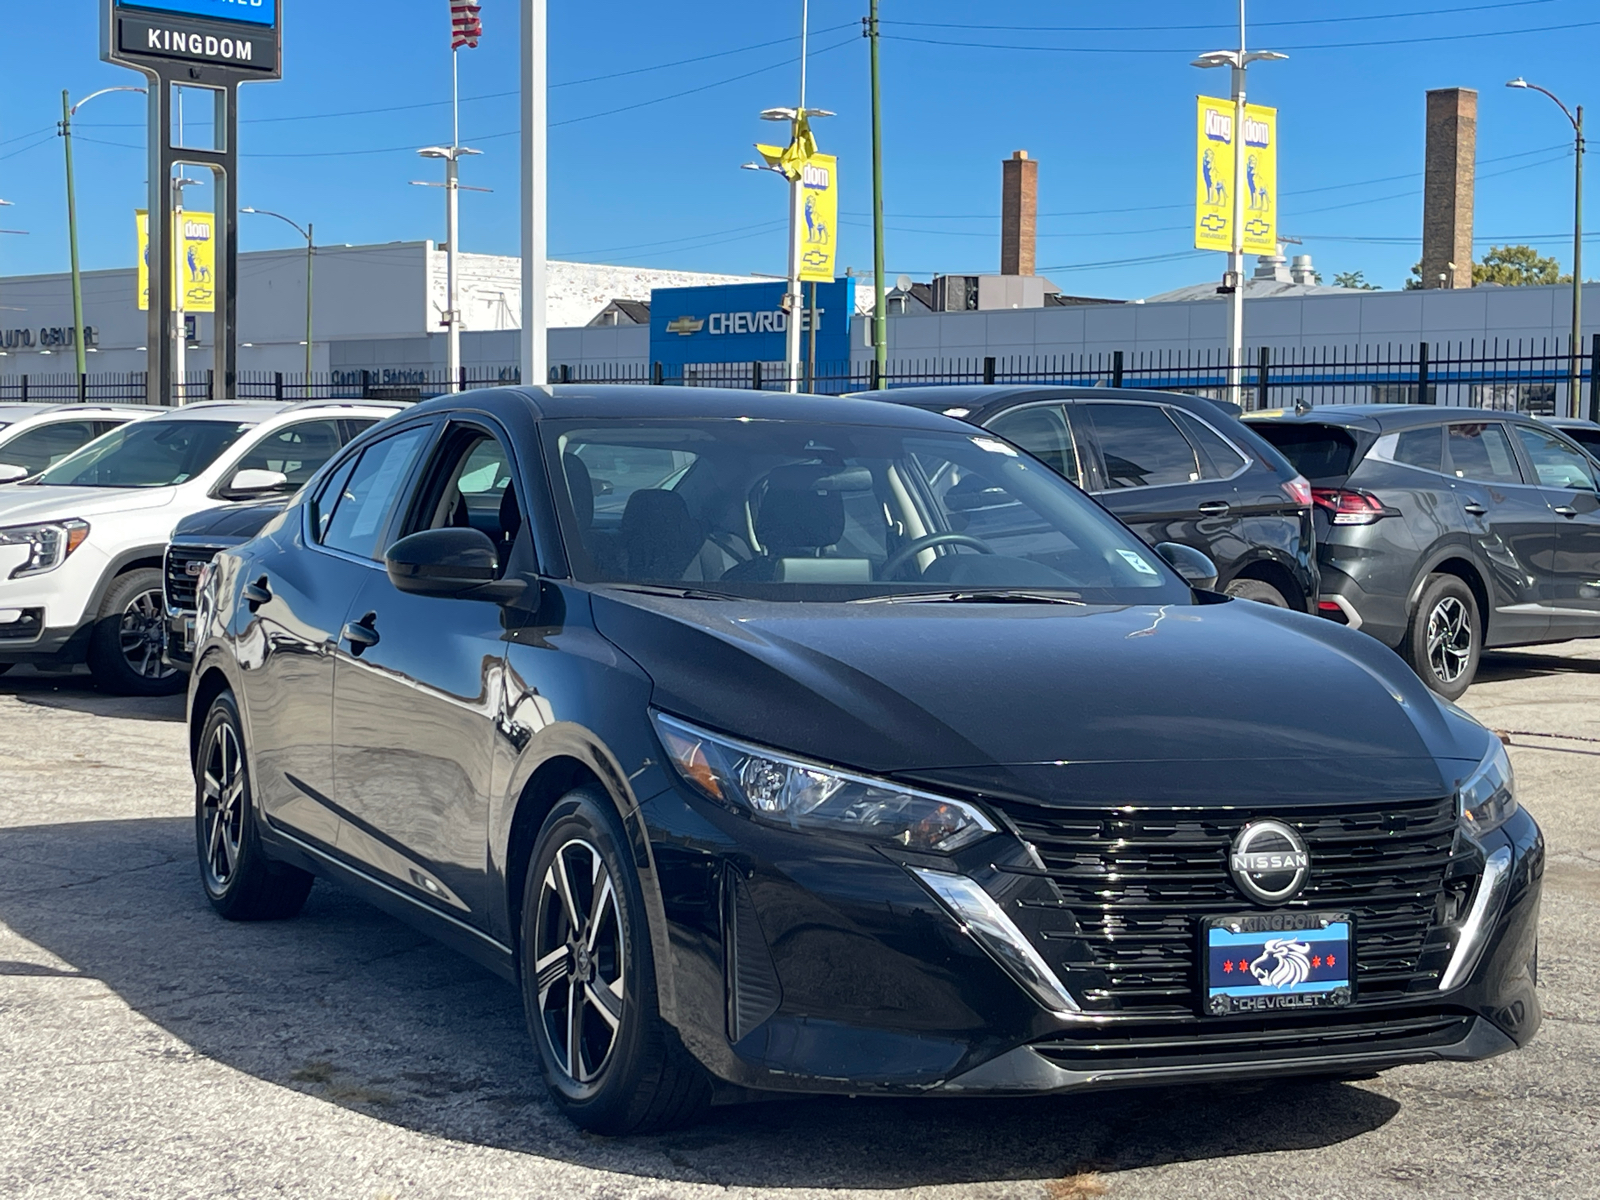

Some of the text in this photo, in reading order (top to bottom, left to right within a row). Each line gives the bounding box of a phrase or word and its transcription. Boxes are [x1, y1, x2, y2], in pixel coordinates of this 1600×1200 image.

[148, 28, 252, 60] KINGDOM
[1205, 108, 1232, 145] King
[1245, 116, 1269, 148] dom
[803, 163, 830, 189] dom
[185, 220, 210, 240] dom
[709, 308, 825, 335] CHEVROET
[40, 325, 98, 346] CENTR
[1234, 854, 1307, 870] NISSAN
[1242, 914, 1320, 931] KINGDOM
[1239, 994, 1320, 1010] CHEVROLET
